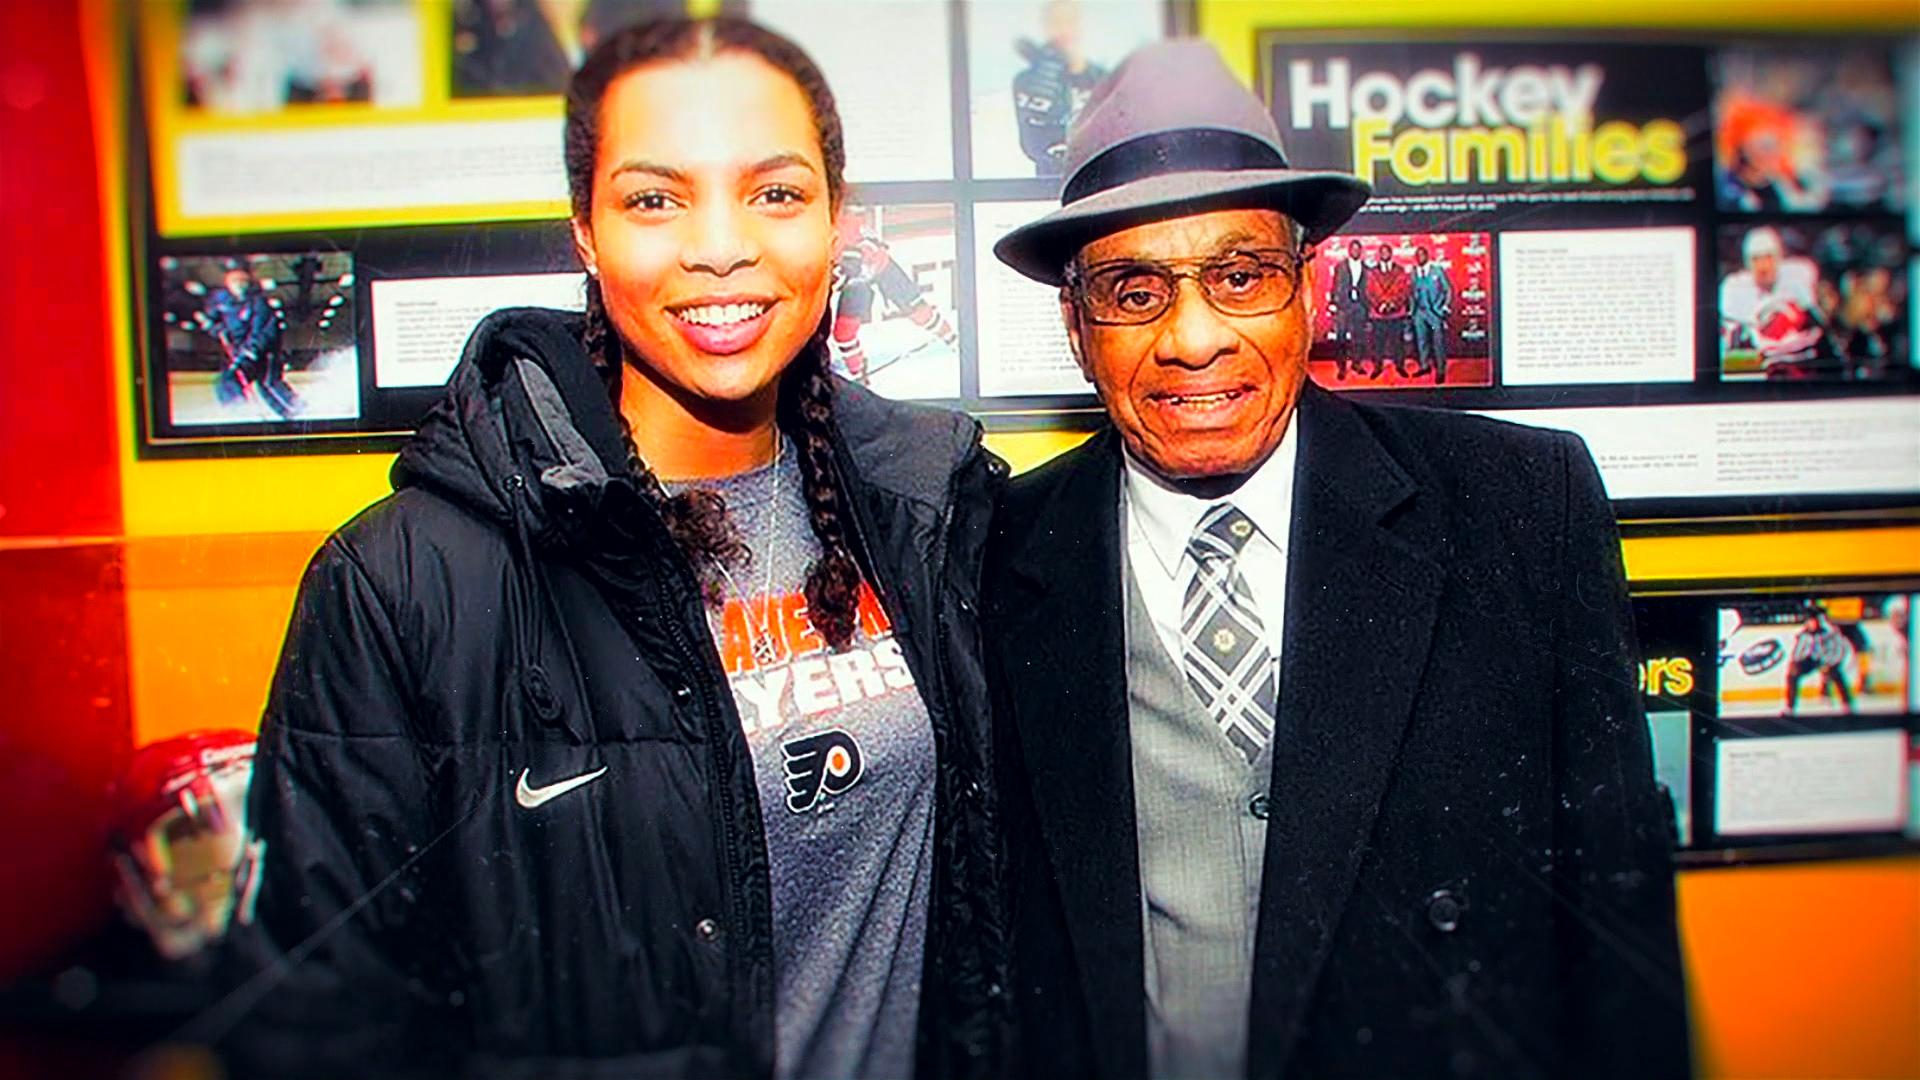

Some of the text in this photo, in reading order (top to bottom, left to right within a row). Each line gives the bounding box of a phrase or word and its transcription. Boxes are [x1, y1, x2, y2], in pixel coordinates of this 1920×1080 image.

[1290, 52, 1603, 133] Hockey
[1352, 113, 1687, 185] Families
[733, 636, 915, 732] YERS
[1638, 657, 1694, 696] rs
